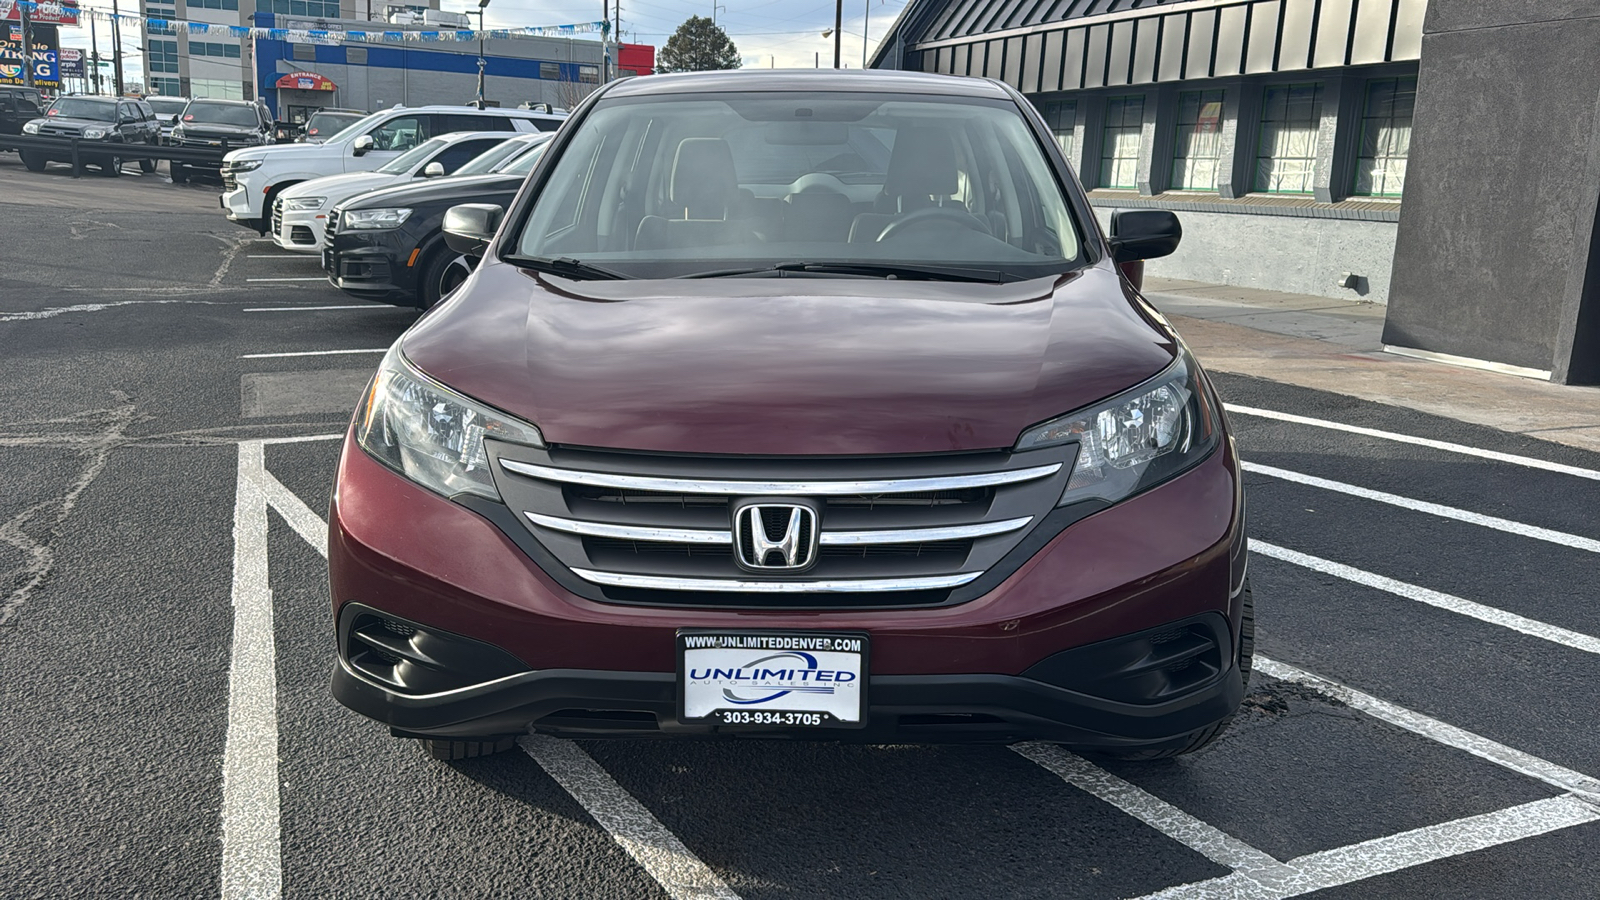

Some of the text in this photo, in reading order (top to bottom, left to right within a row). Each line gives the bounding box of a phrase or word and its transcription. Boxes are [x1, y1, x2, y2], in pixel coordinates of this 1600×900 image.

[34, 79, 59, 88] elivery
[290, 72, 322, 80] ENTRANCE
[684, 636, 861, 652] WWWUNLIMITEDDENVER.COM
[690, 668, 856, 683] UNLIMITED
[723, 711, 821, 726] 303-934-3705
